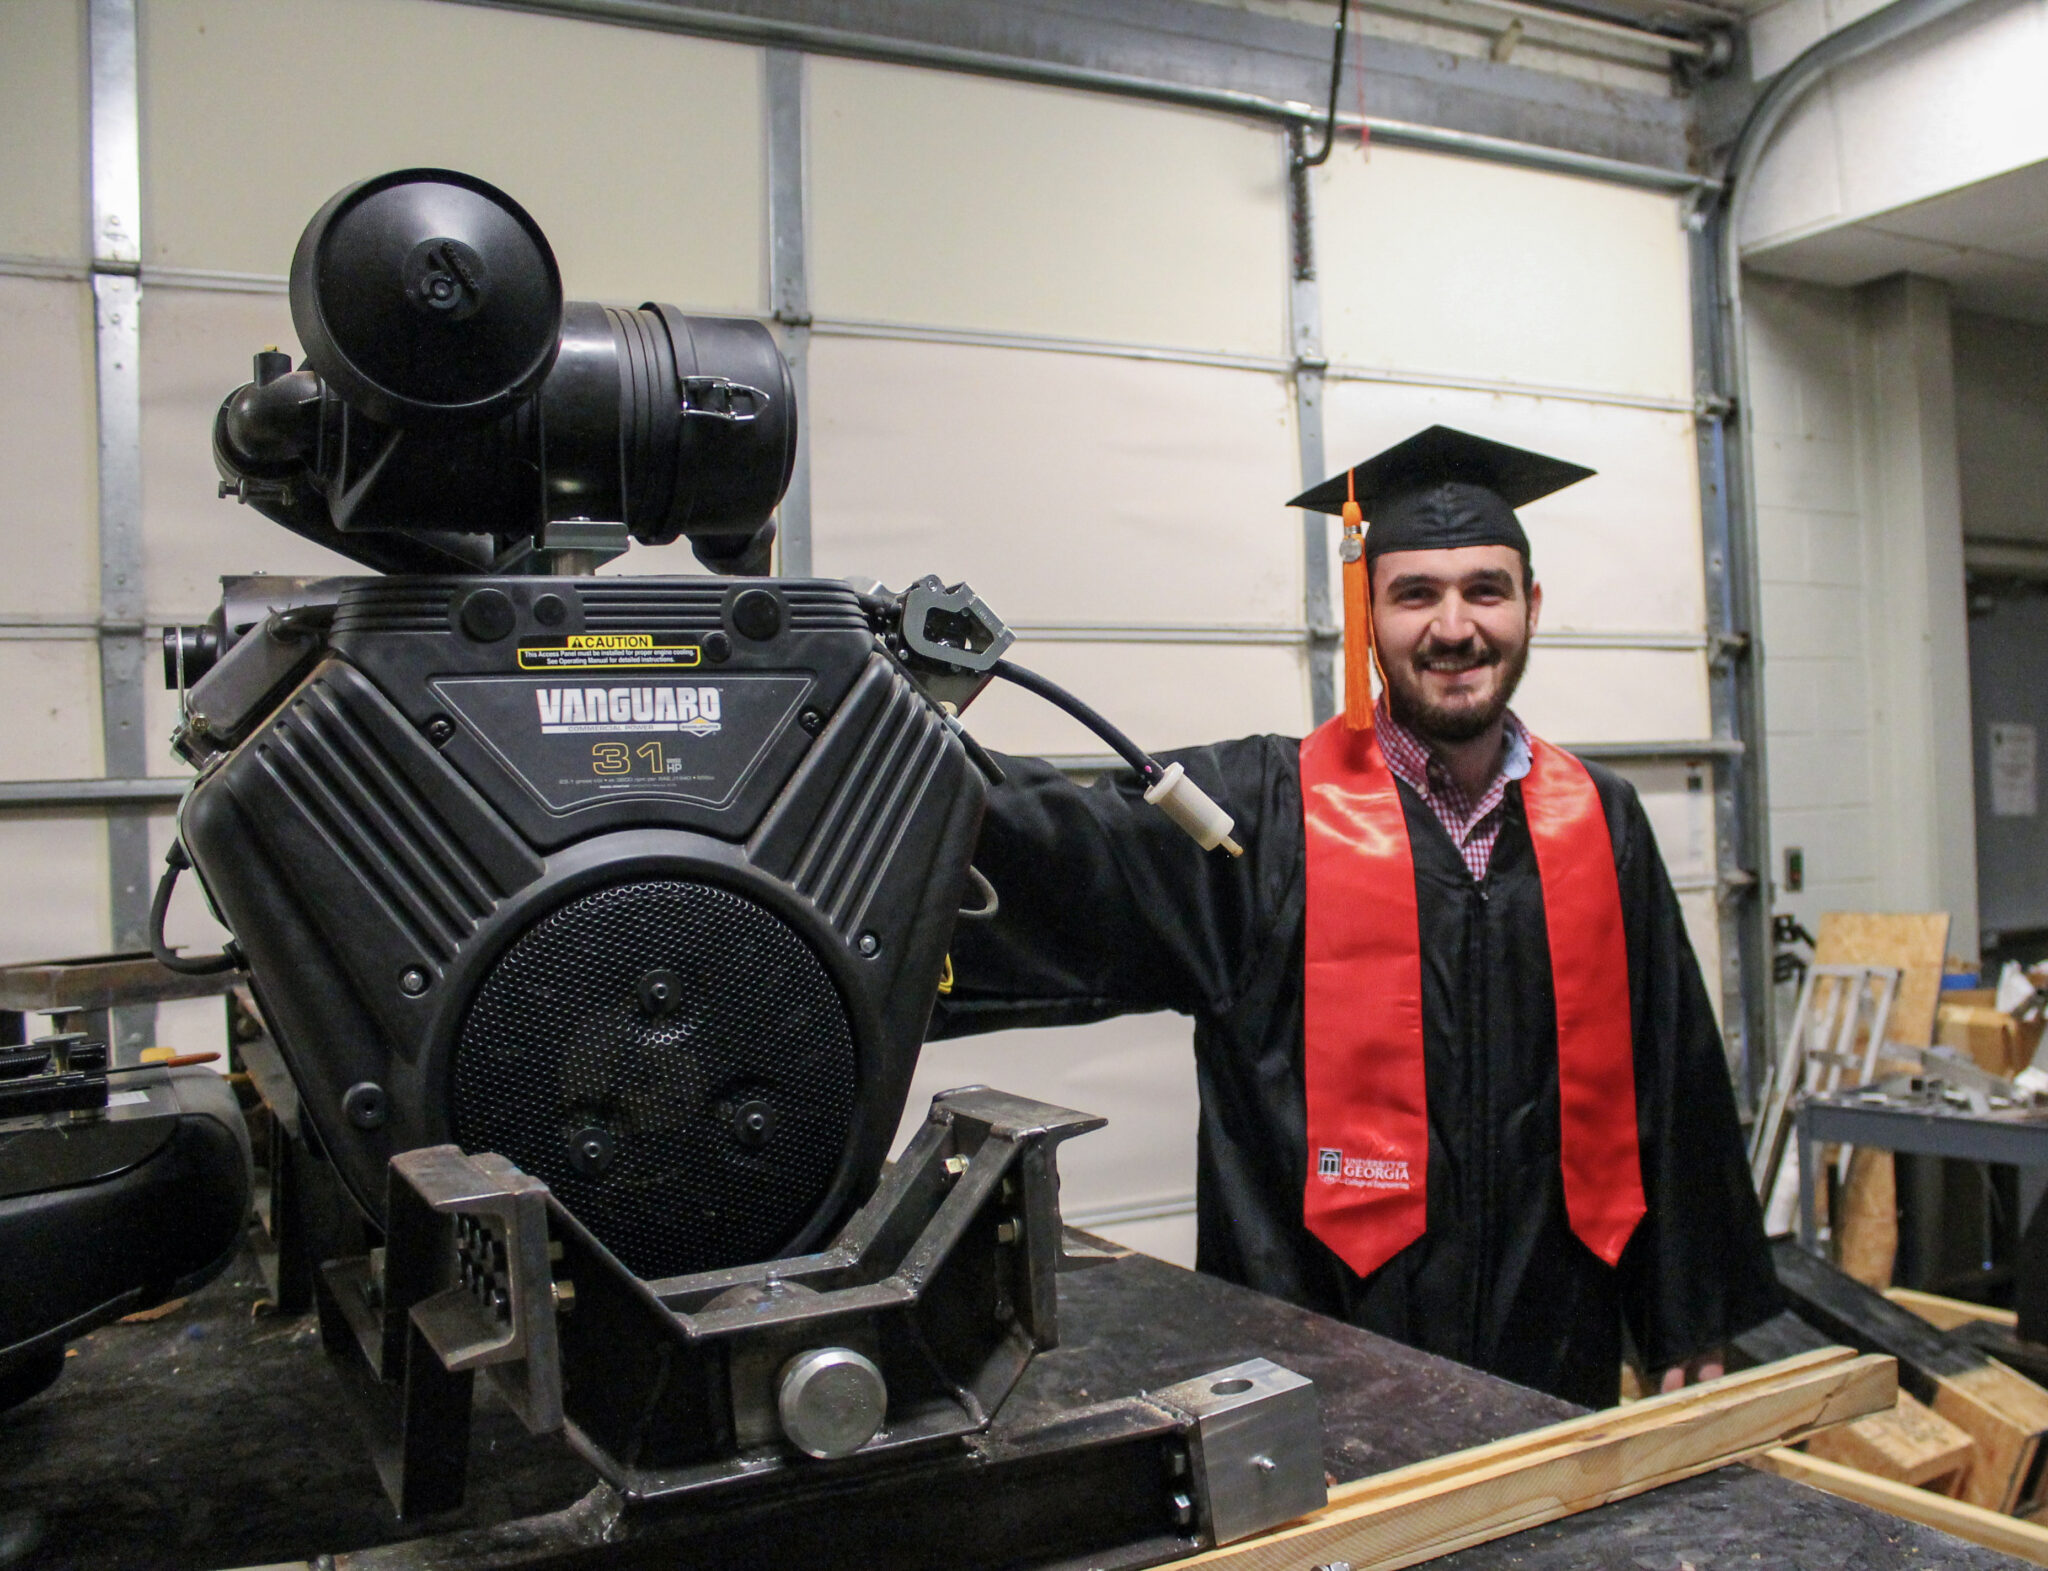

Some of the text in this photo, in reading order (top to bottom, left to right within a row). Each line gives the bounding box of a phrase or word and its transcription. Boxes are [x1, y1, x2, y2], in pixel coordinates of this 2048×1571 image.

[585, 636, 648, 648] CAUTION
[538, 650, 560, 658] Access
[600, 649, 625, 657] installed
[653, 649, 673, 657] engine
[559, 657, 588, 666] Operating
[536, 686, 721, 724] VANGUARD
[568, 724, 654, 732] COMMERCIAL POWER
[592, 742, 682, 775] 31 HP
[1344, 1158, 1395, 1168] UNIVERSITY
[1343, 1166, 1409, 1181] GEORGIA
